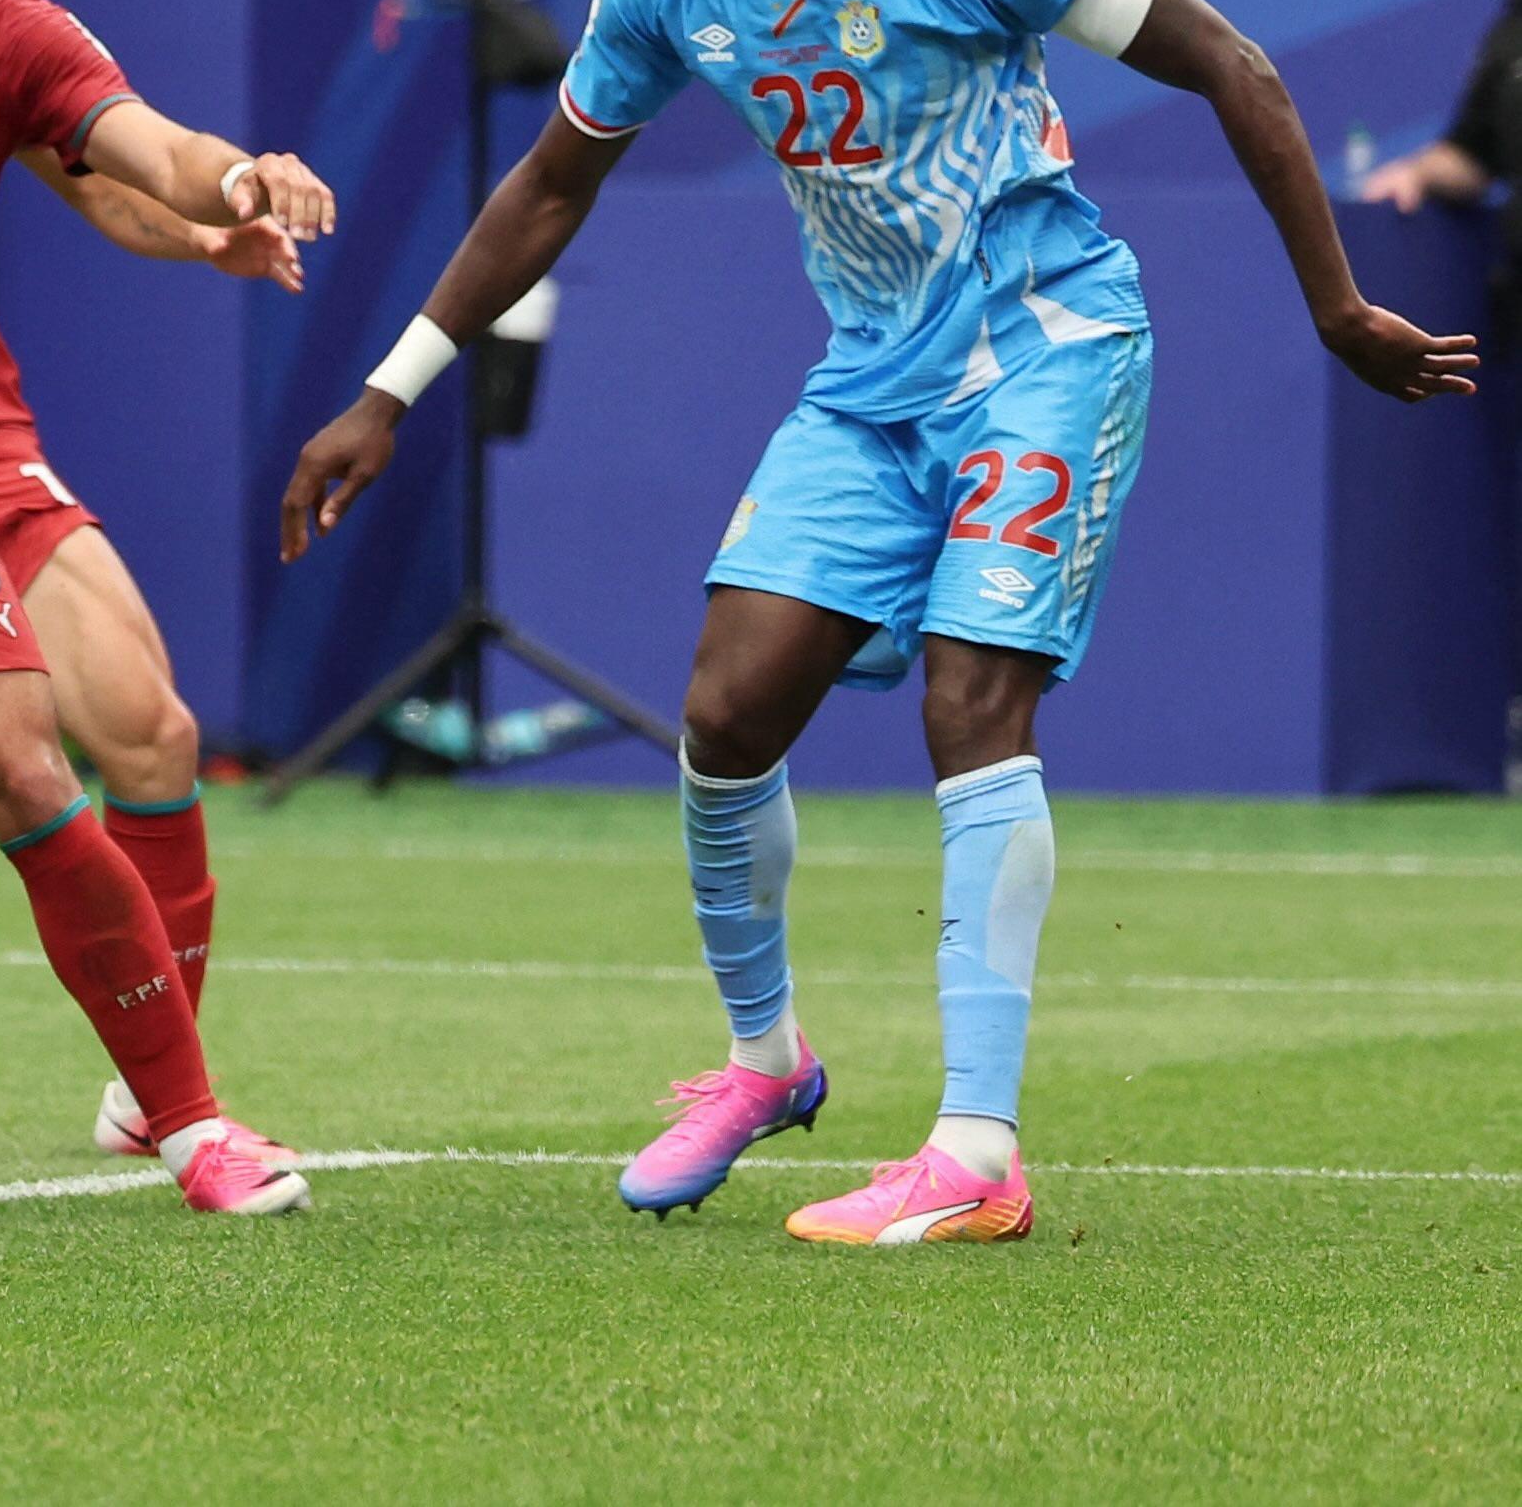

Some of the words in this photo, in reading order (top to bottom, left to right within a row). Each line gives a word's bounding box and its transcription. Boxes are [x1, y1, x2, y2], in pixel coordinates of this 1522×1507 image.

[750, 69, 884, 167] 22
[947, 448, 1073, 559] 22
[978, 587, 1026, 609] umbro
